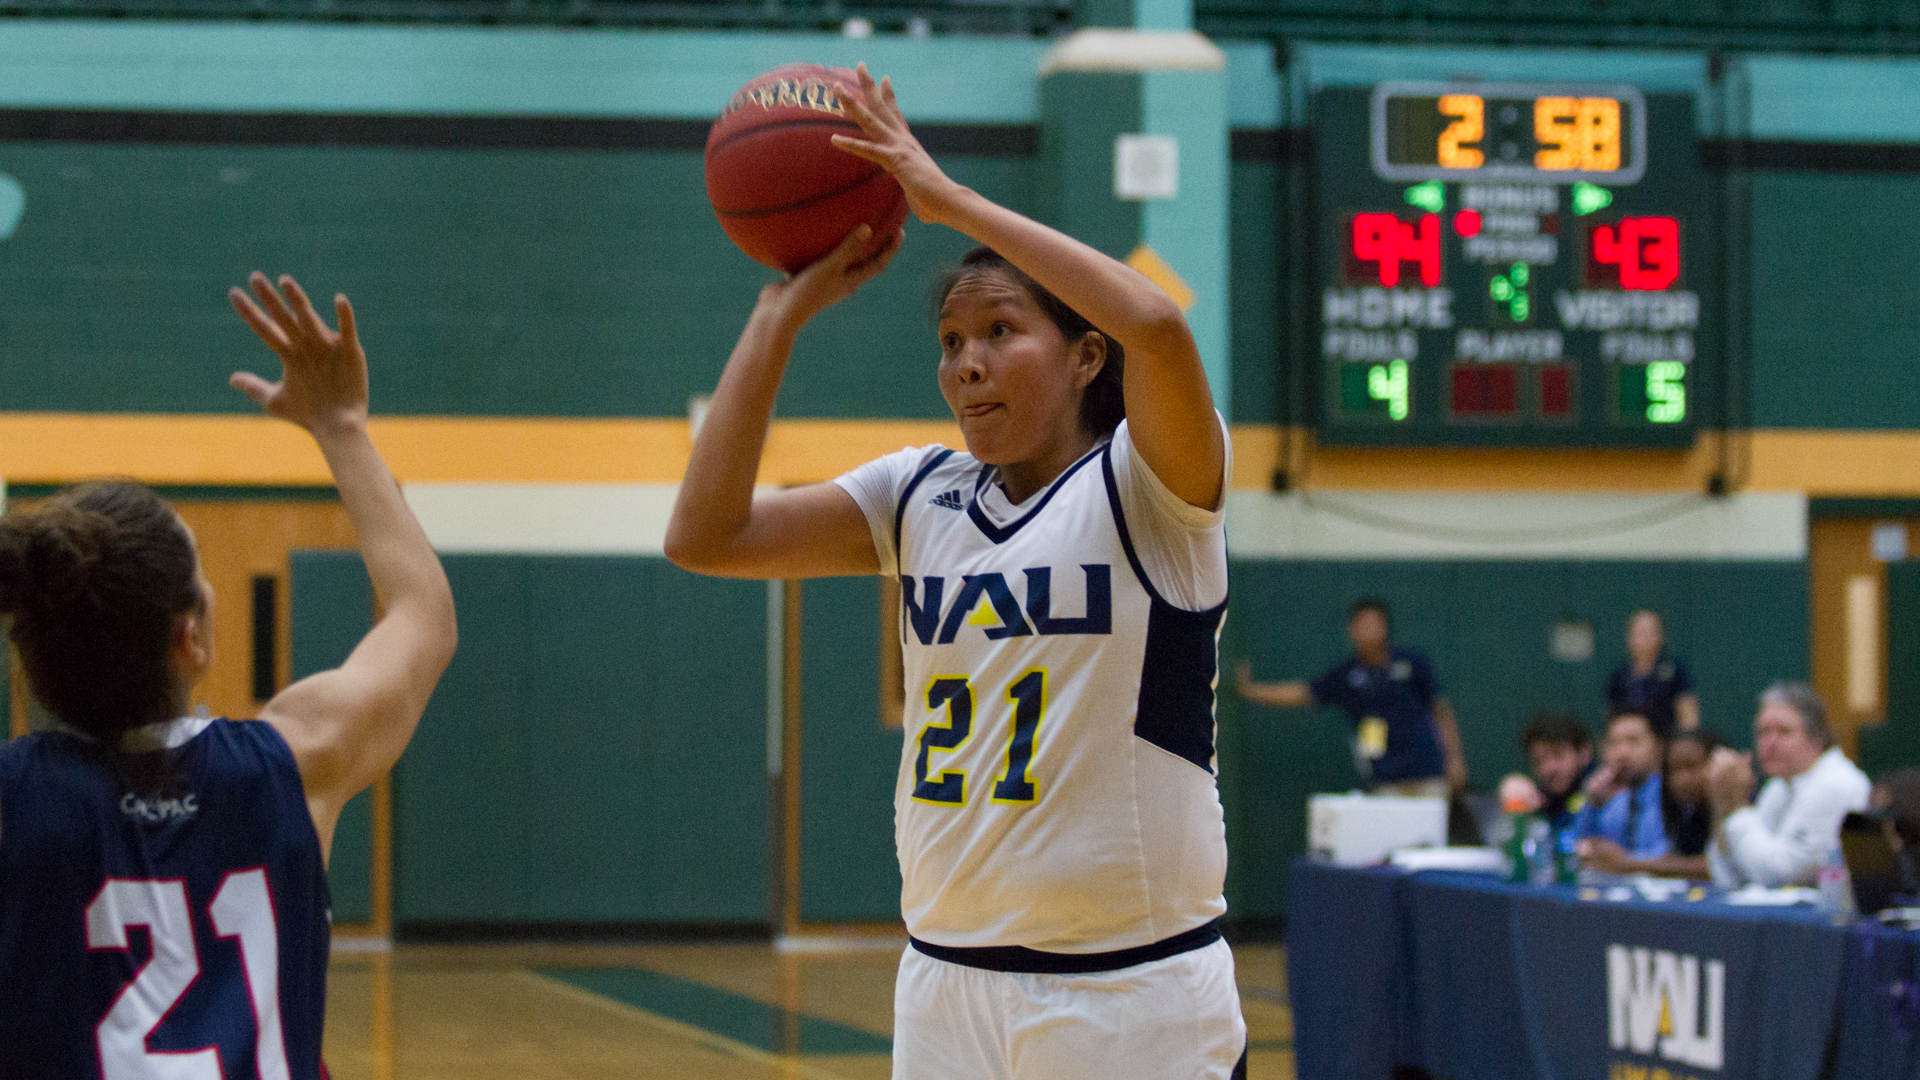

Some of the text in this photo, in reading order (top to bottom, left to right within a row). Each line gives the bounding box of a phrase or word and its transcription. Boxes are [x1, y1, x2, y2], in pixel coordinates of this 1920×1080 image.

[1437, 94, 1485, 169] 2
[1352, 211, 1441, 287] 94
[1593, 215, 1680, 290] 43
[1322, 288, 1455, 327] HOME
[1555, 289, 1700, 330] VISITOR
[1368, 359, 1409, 421] 4
[1646, 360, 1686, 423] 5
[901, 563, 1112, 646] NAU
[911, 666, 1049, 808] 21
[83, 863, 293, 1080] 21
[1605, 942, 1726, 1071] NAU
